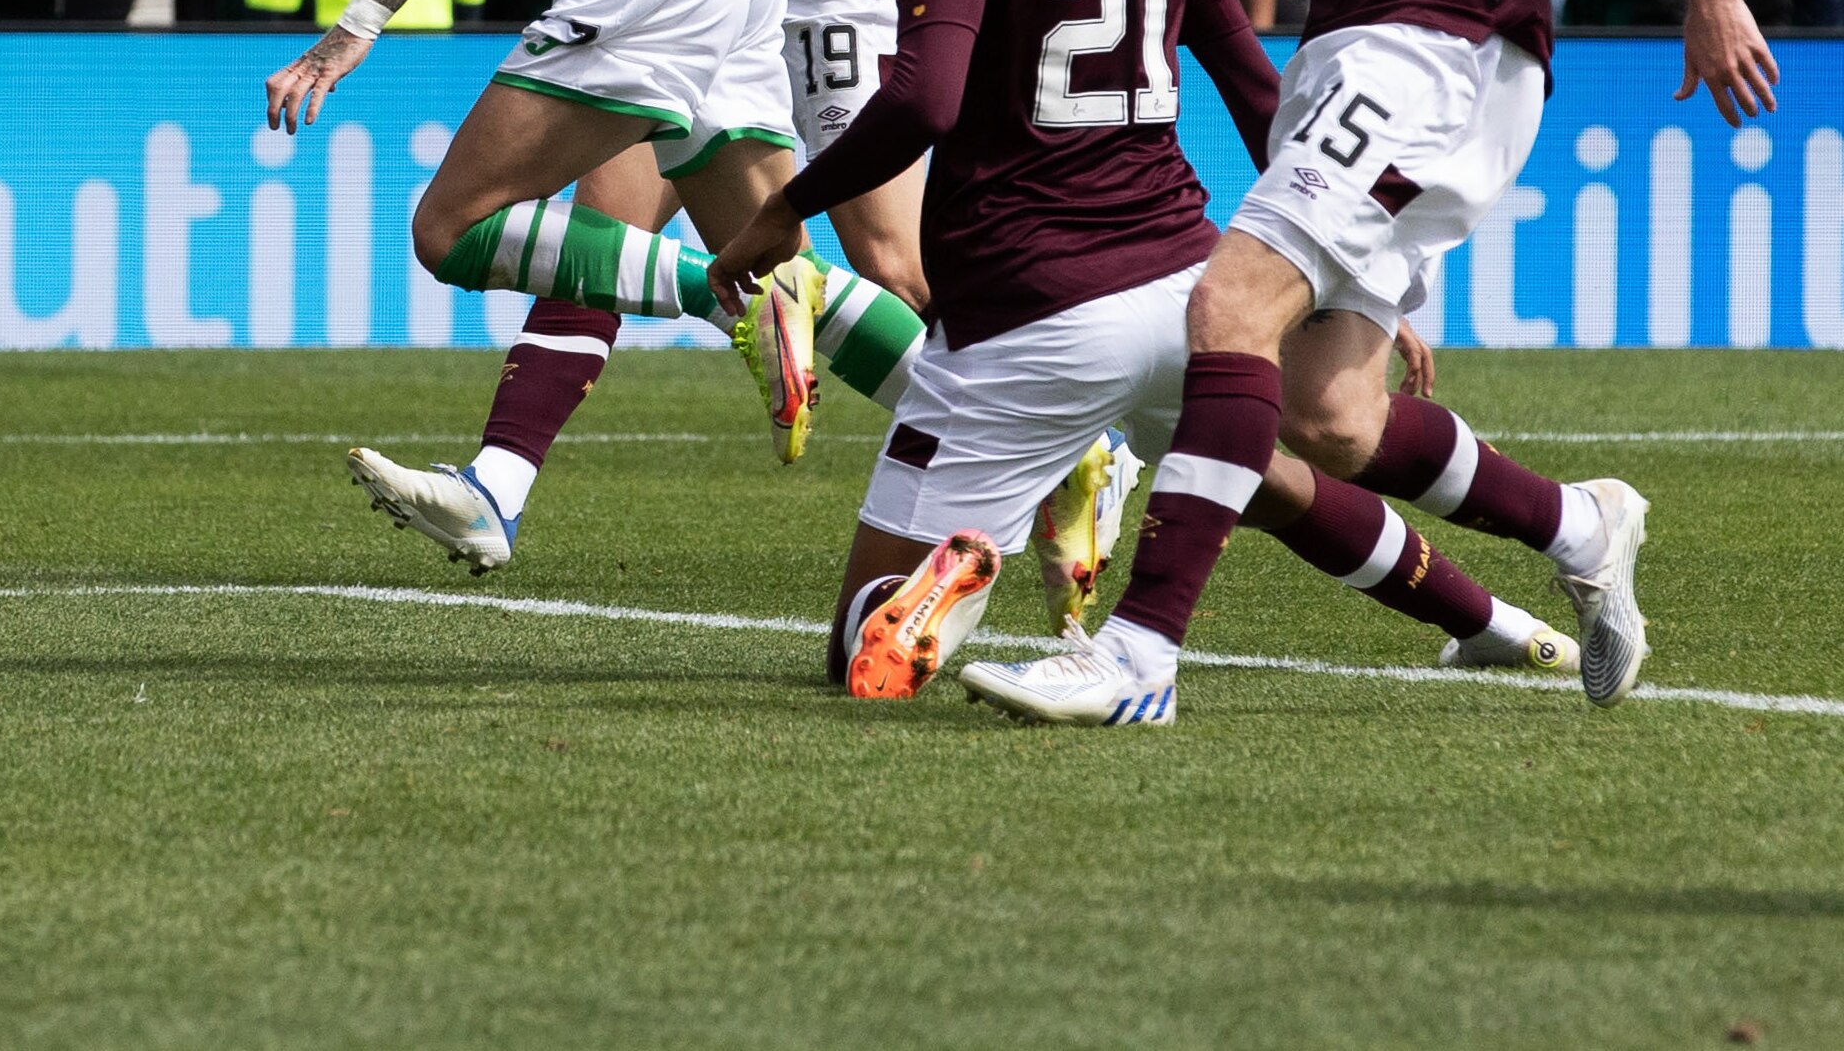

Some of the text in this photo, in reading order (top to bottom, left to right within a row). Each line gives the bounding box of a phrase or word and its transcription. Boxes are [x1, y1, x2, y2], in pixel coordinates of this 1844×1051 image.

[799, 24, 859, 97] 19
[821, 122, 847, 131] umbro
[1292, 81, 1392, 168] 15
[1289, 180, 1317, 200] umbro
[1407, 532, 1431, 589] HEAR
